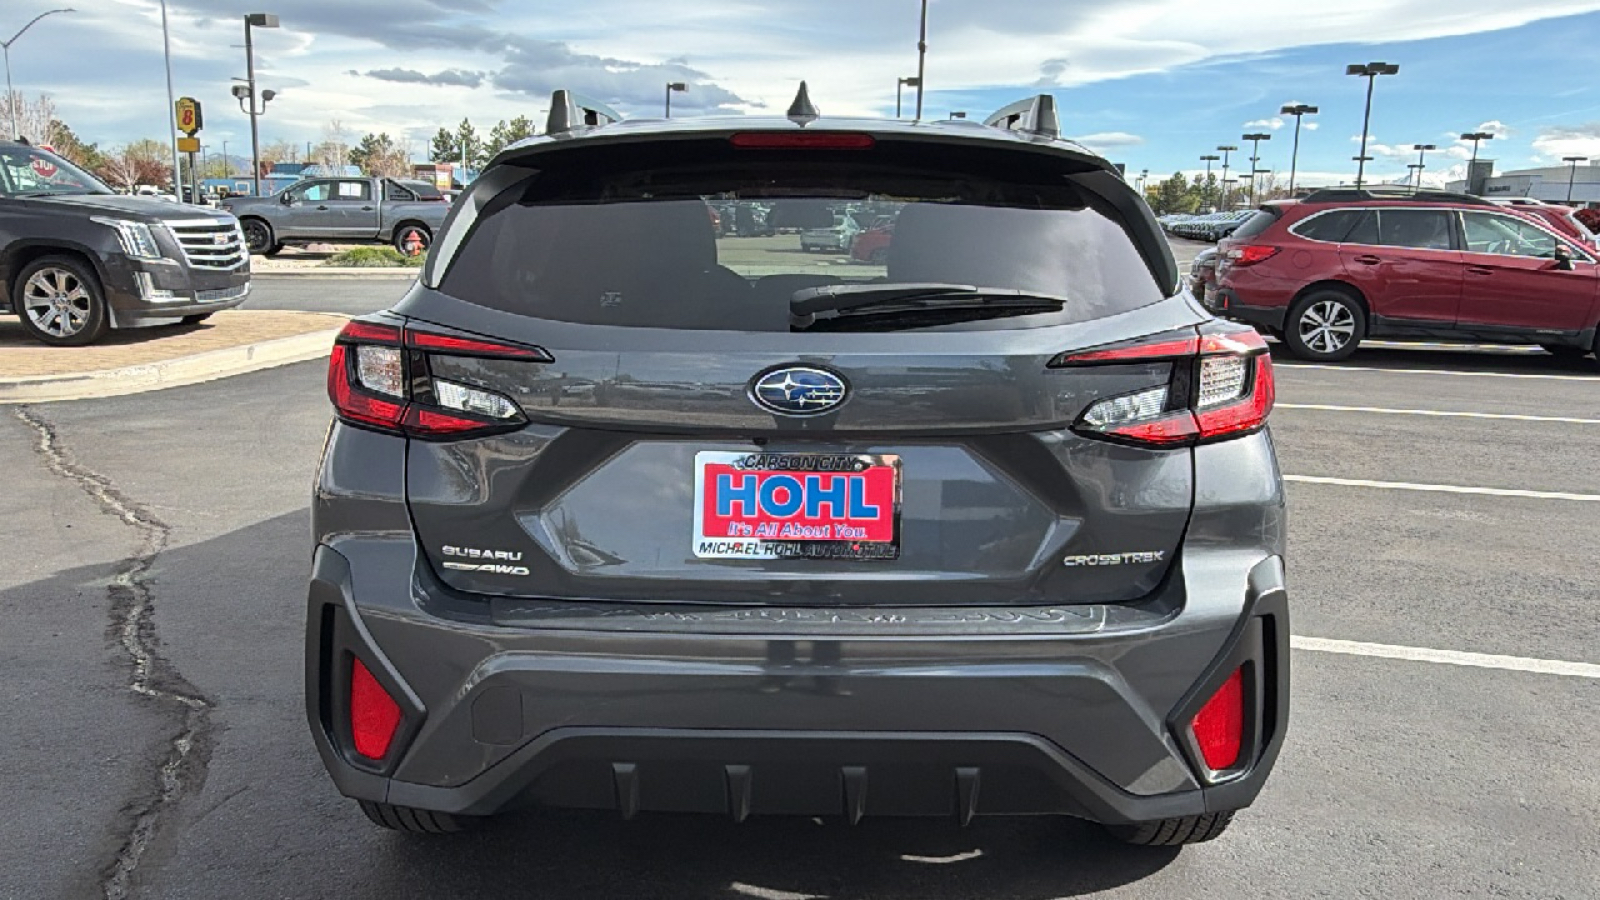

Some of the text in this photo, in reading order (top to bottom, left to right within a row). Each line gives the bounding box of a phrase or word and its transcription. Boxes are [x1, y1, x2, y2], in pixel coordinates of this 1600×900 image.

[182, 109, 193, 125] 8
[744, 454, 857, 470] CARSON CITY
[716, 474, 880, 519] HOHL
[727, 521, 868, 538] It's All About You.
[442, 545, 523, 561] SUBARU
[699, 542, 760, 555] MICHAEL
[764, 543, 801, 556] HOHL
[1063, 550, 1165, 566] CROSSTREK
[476, 564, 530, 576] AWD
